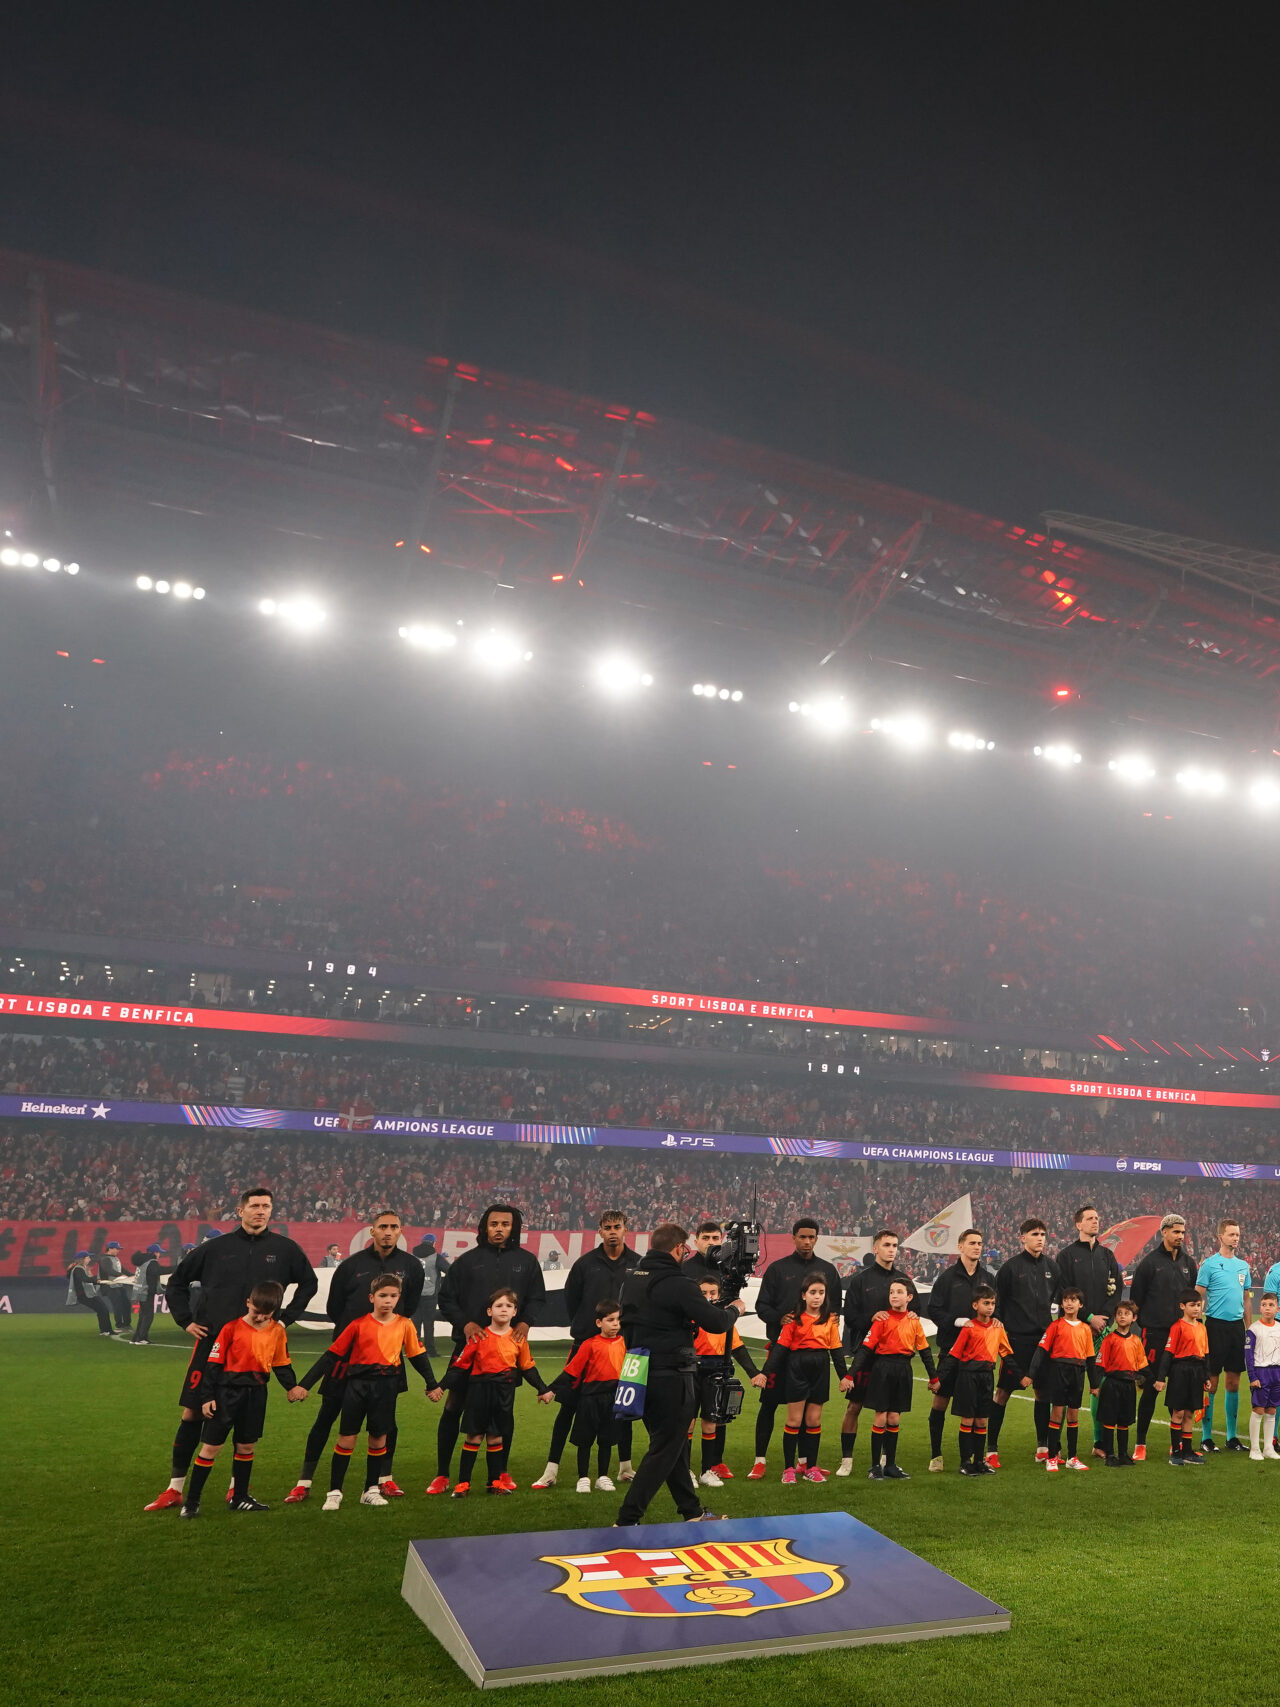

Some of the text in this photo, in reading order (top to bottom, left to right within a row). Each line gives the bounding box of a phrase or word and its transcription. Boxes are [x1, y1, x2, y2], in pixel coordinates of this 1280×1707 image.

[26, 1000, 93, 1016] LISBOA
[101, 1005, 112, 1017] E
[119, 1007, 194, 1023] BENFICA
[651, 994, 814, 1019] SPORT LISBOA E BENFICA
[1070, 1083, 1196, 1102] SPORT LISBOA E BENFICA
[21, 1102, 86, 1115] Heineken
[313, 1116, 495, 1136] UEF AMPIONS LEAGUE
[862, 1146, 995, 1163] UEFA CHAMPIONS LEAGUE
[1133, 1161, 1162, 1172] PEPSI
[189, 1370, 202, 1390] 9
[615, 1385, 636, 1407] 10
